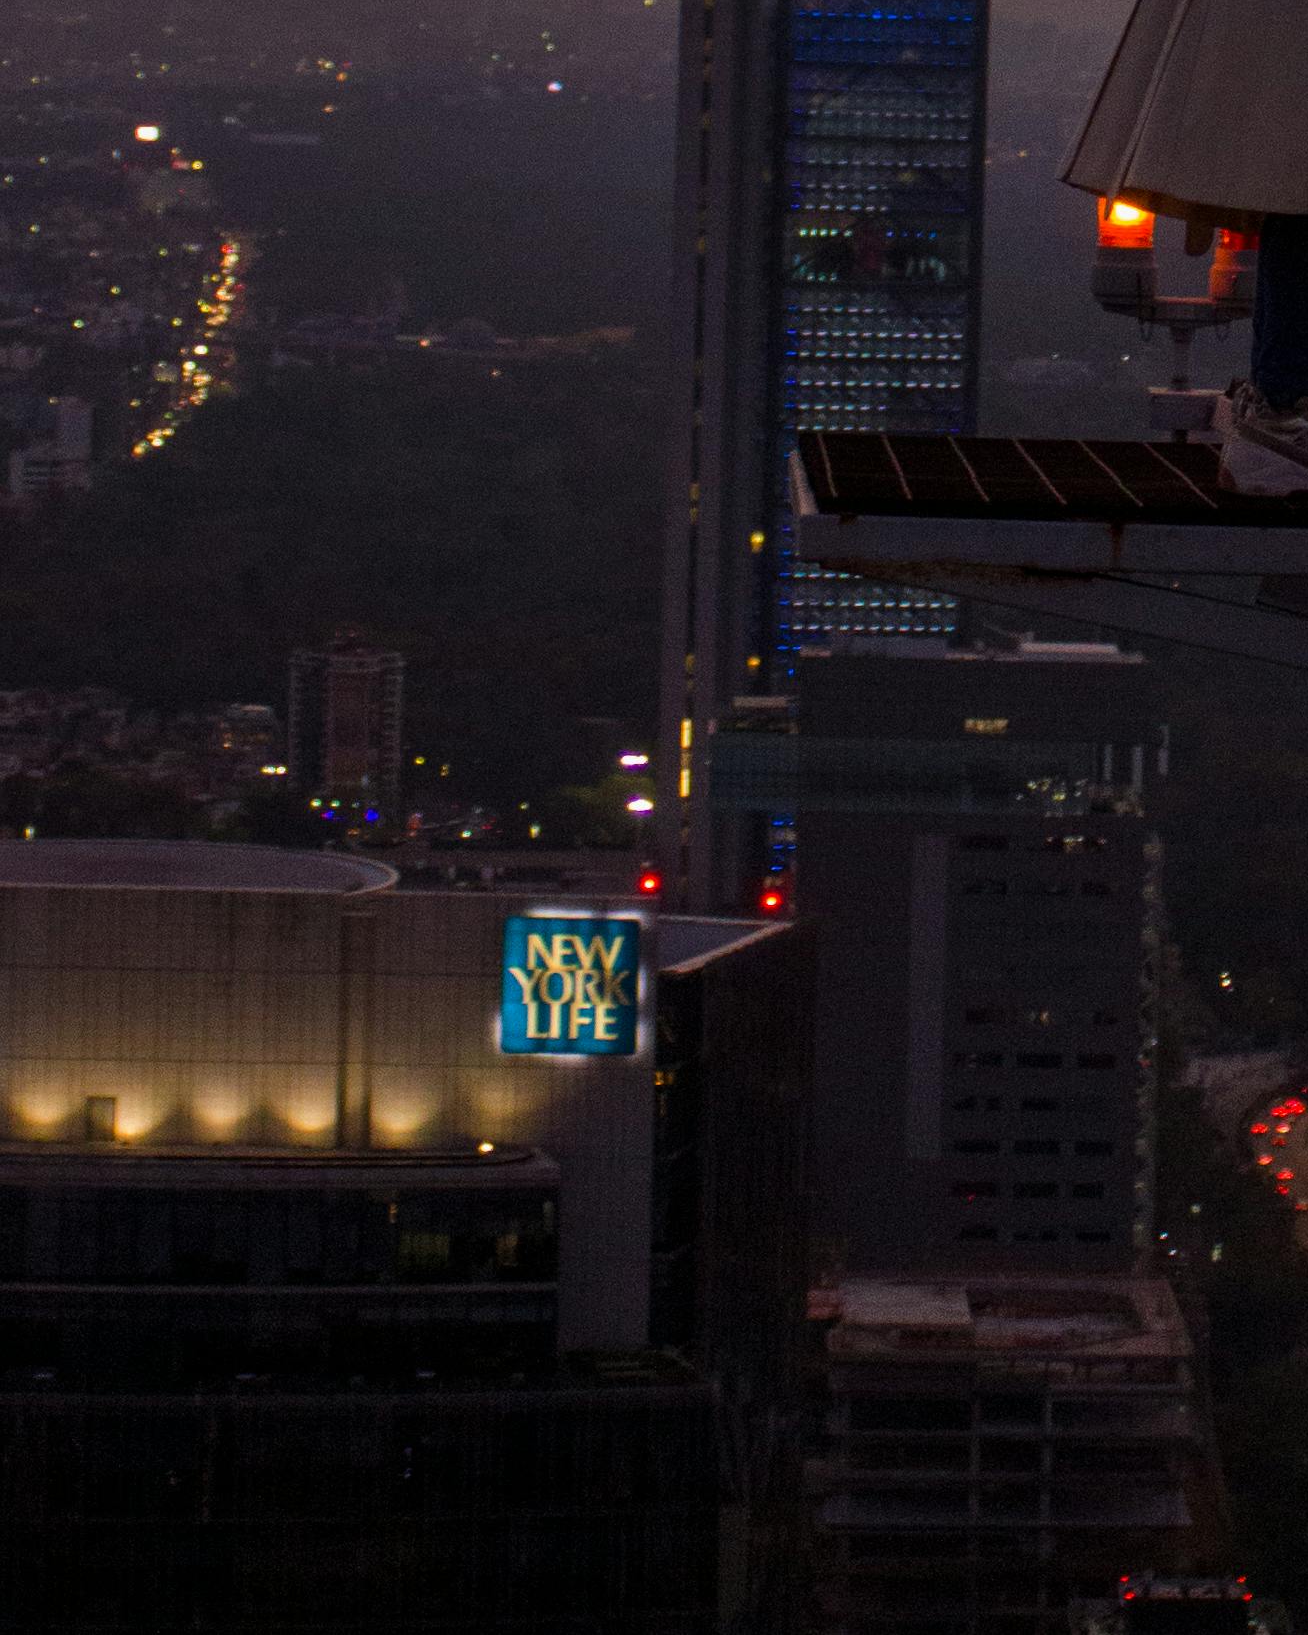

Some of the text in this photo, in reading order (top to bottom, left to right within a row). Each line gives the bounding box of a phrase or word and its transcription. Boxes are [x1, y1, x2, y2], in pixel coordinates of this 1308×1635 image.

[526, 933, 625, 974] NEW
[507, 966, 631, 1006] YORK
[526, 1001, 620, 1041] LIFE
